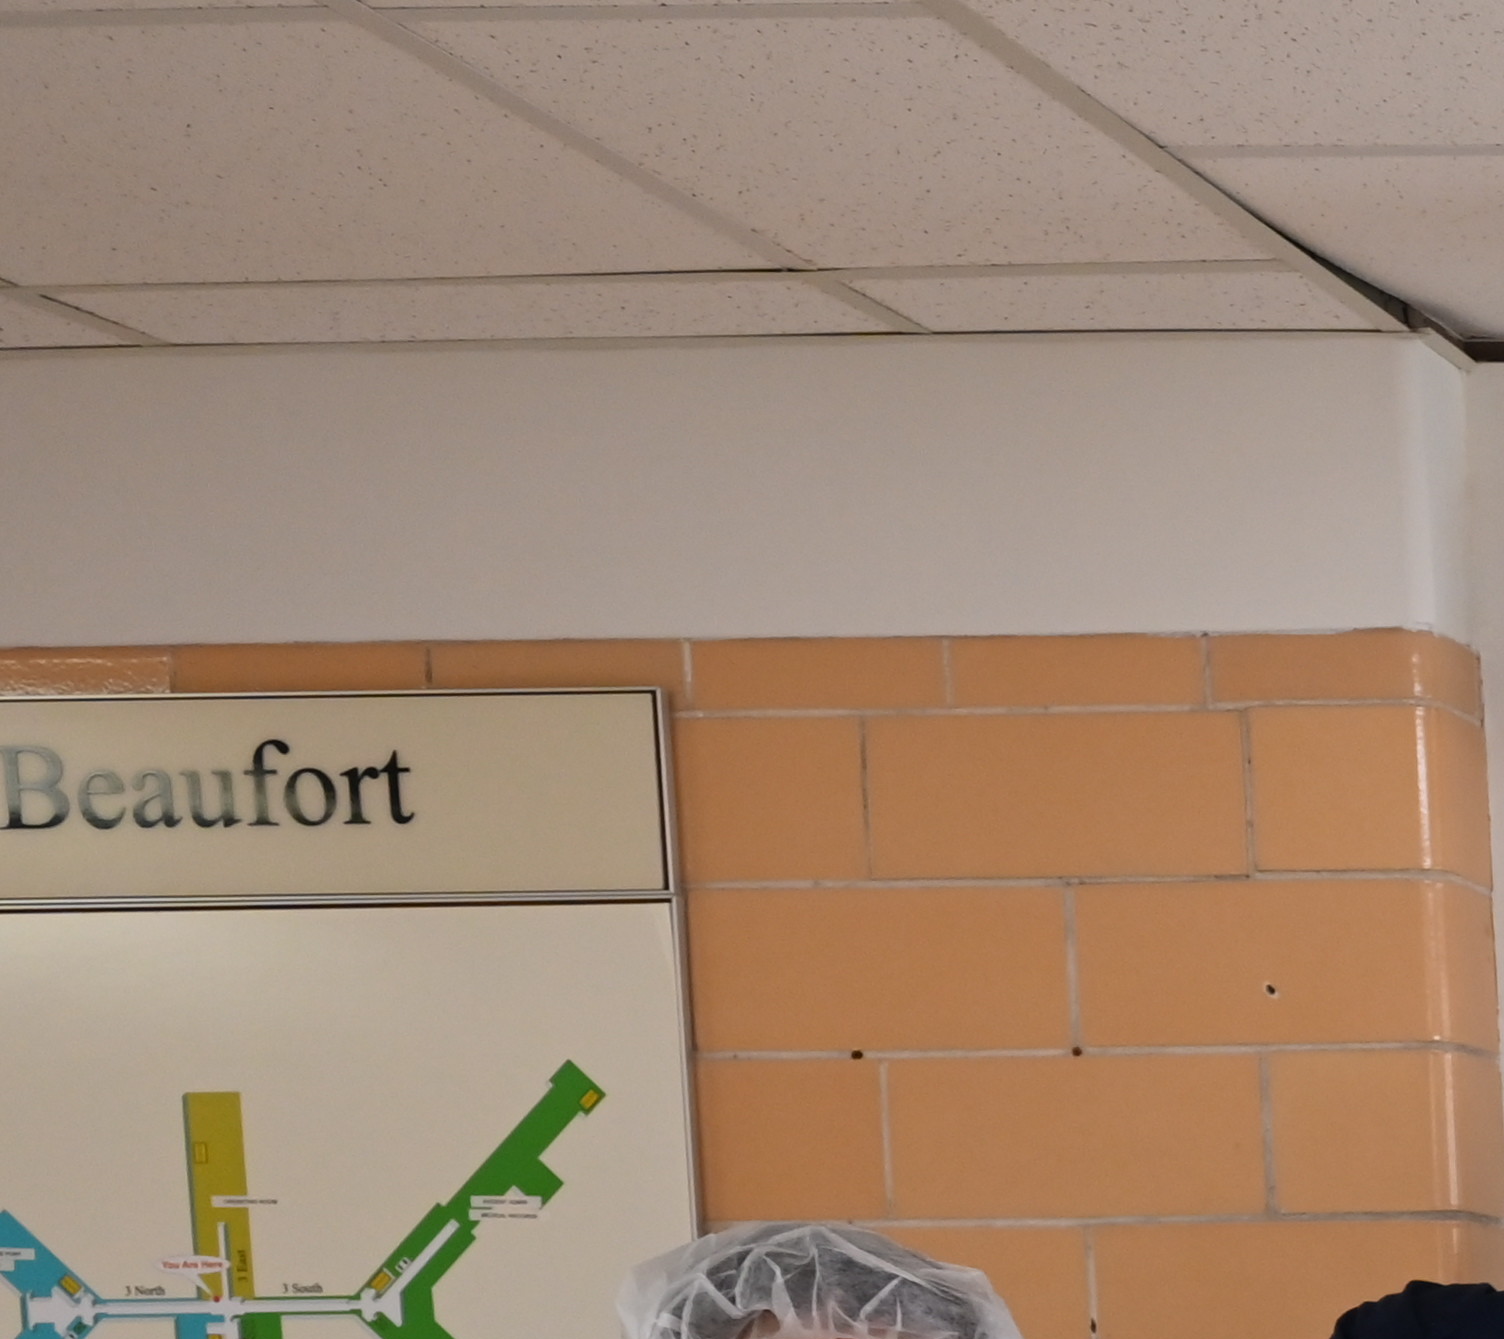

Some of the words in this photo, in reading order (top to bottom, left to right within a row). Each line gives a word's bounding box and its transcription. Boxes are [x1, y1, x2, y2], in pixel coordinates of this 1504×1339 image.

[0, 739, 416, 830] Beaufort
[162, 1261, 180, 1269] You
[201, 1261, 223, 1269] Here
[124, 1286, 131, 1296] 3
[135, 1285, 166, 1296] North
[283, 1284, 289, 1294] 3
[291, 1283, 323, 1294] South
